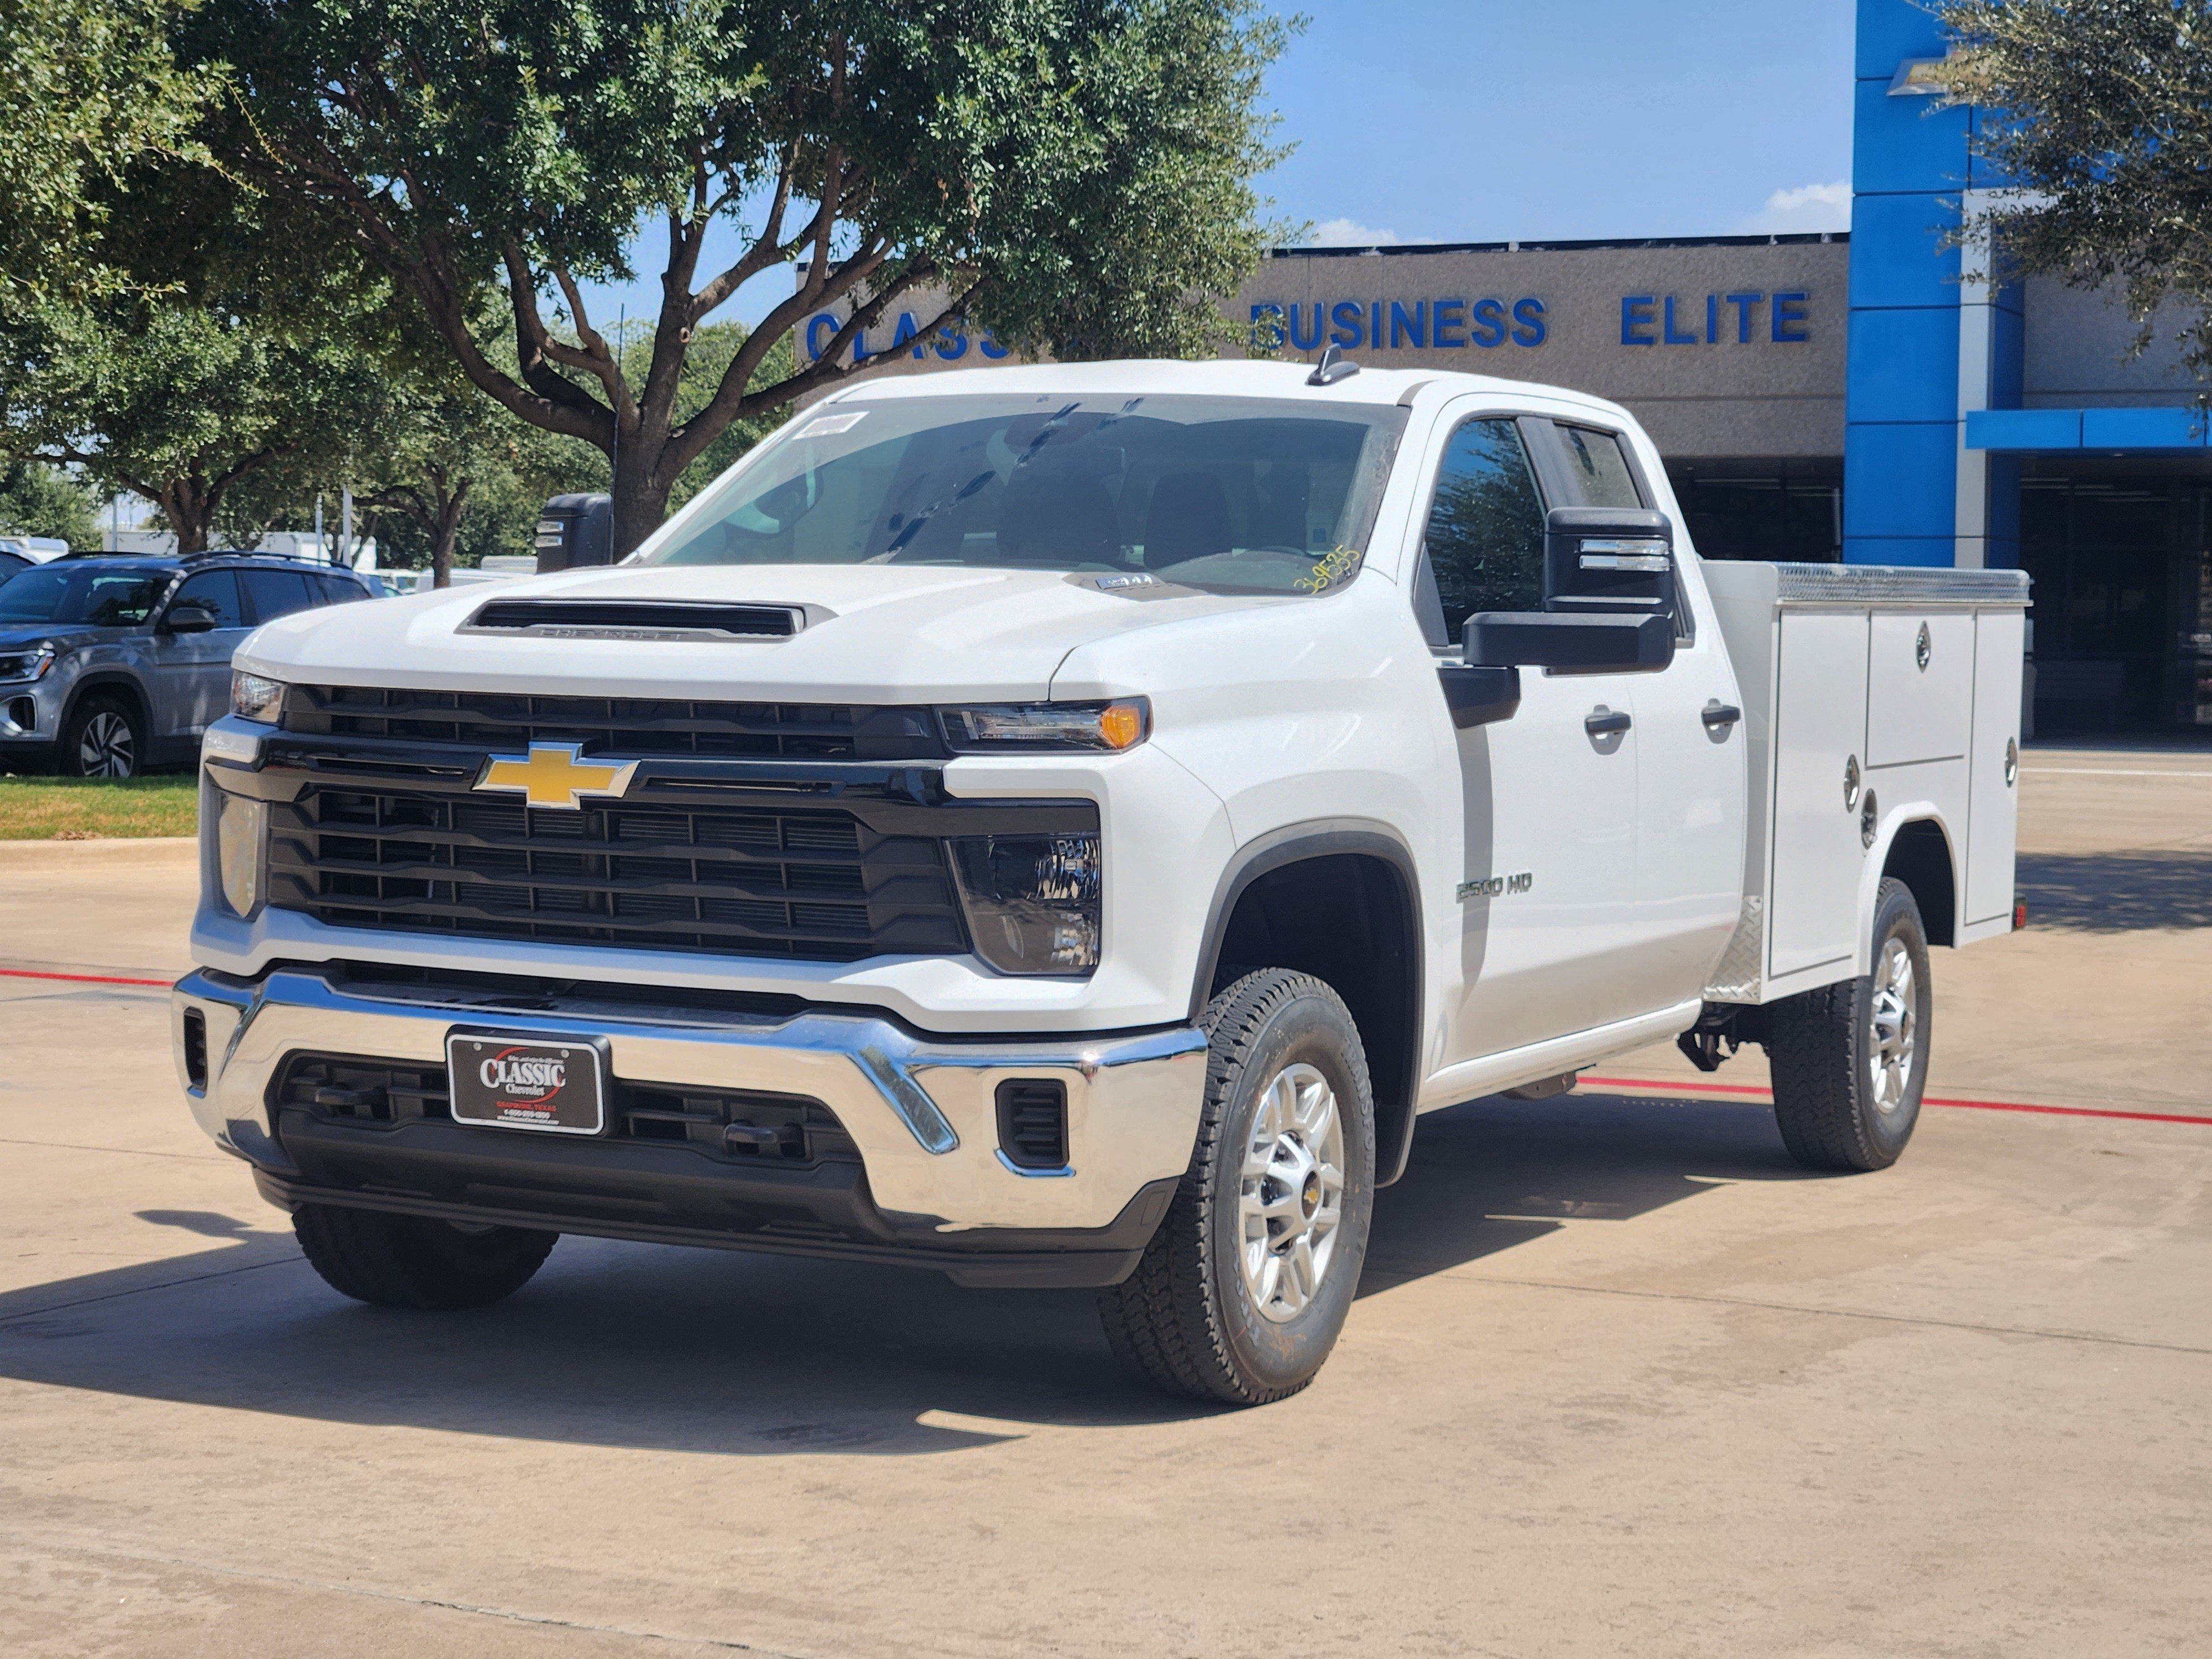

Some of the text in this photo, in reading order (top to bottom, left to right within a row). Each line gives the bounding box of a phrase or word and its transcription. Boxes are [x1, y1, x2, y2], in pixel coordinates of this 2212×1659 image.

[807, 293, 1808, 361] CLASS BUSINESS ELITE
[1457, 873, 1532, 900] 2500 HD
[480, 1058, 566, 1088] CLASSIC
